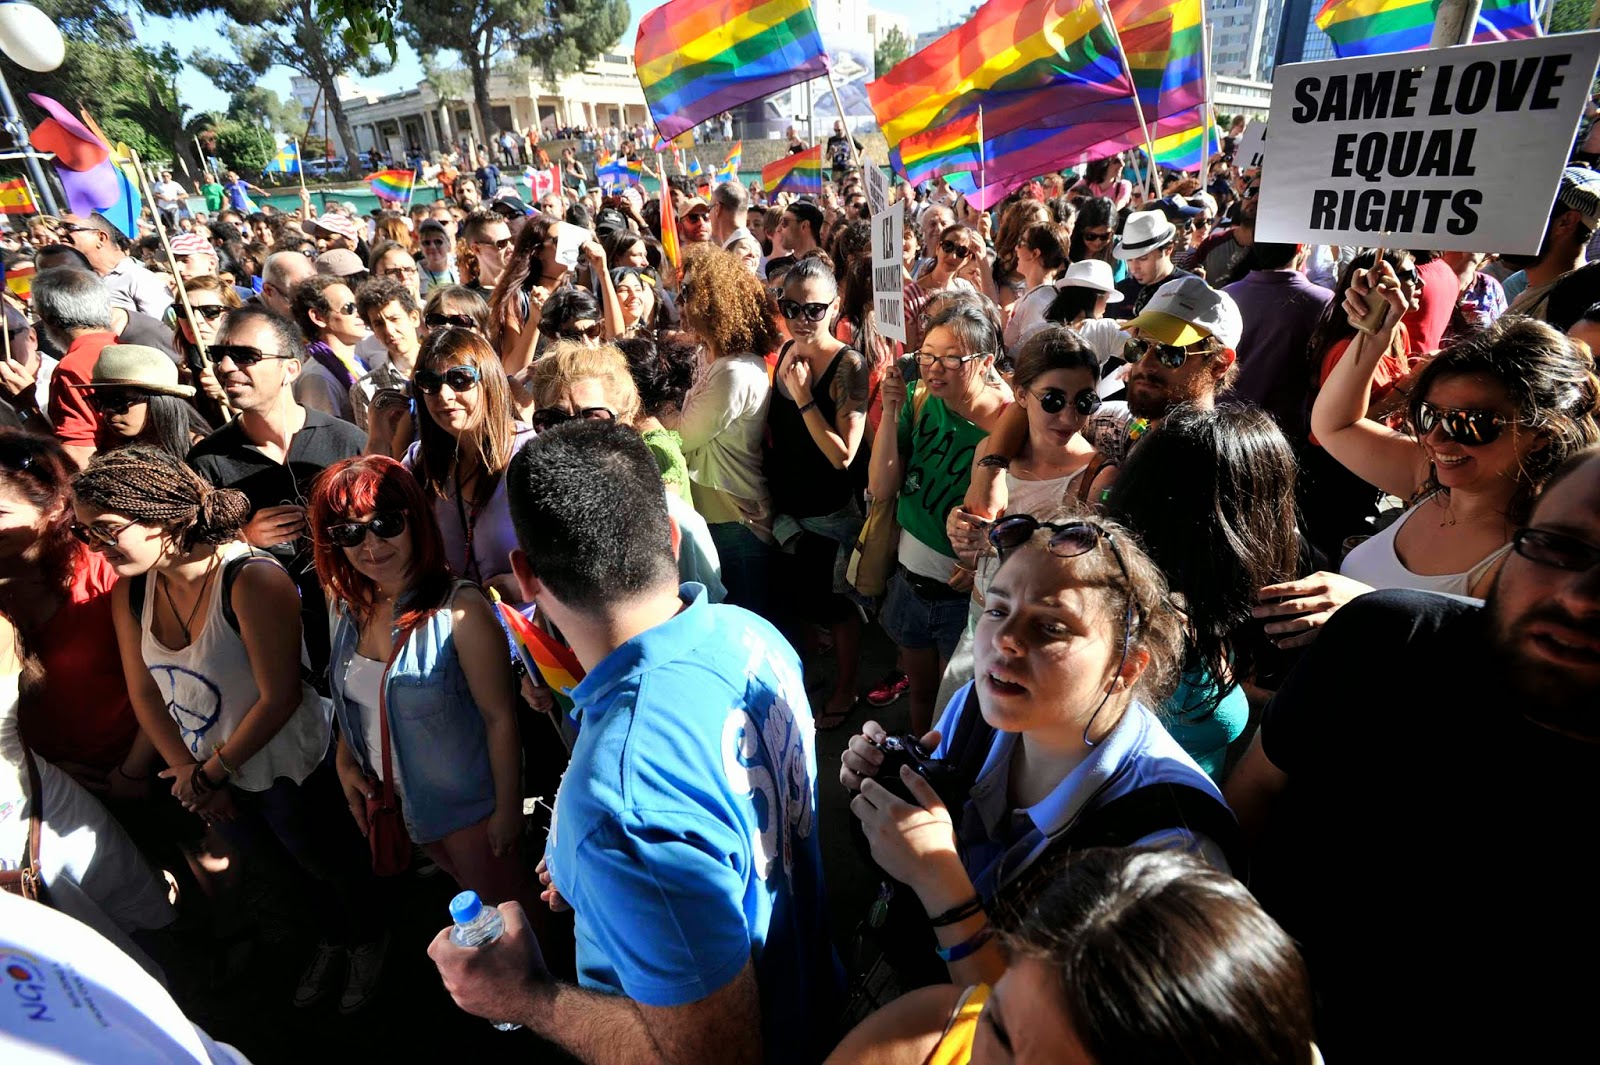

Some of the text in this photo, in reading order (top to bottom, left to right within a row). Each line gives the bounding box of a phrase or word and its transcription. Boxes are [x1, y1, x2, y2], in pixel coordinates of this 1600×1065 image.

[1292, 54, 1572, 124] SAME LOVE
[1331, 128, 1478, 182] EQUAL
[1309, 189, 1483, 235] RIGHTS
